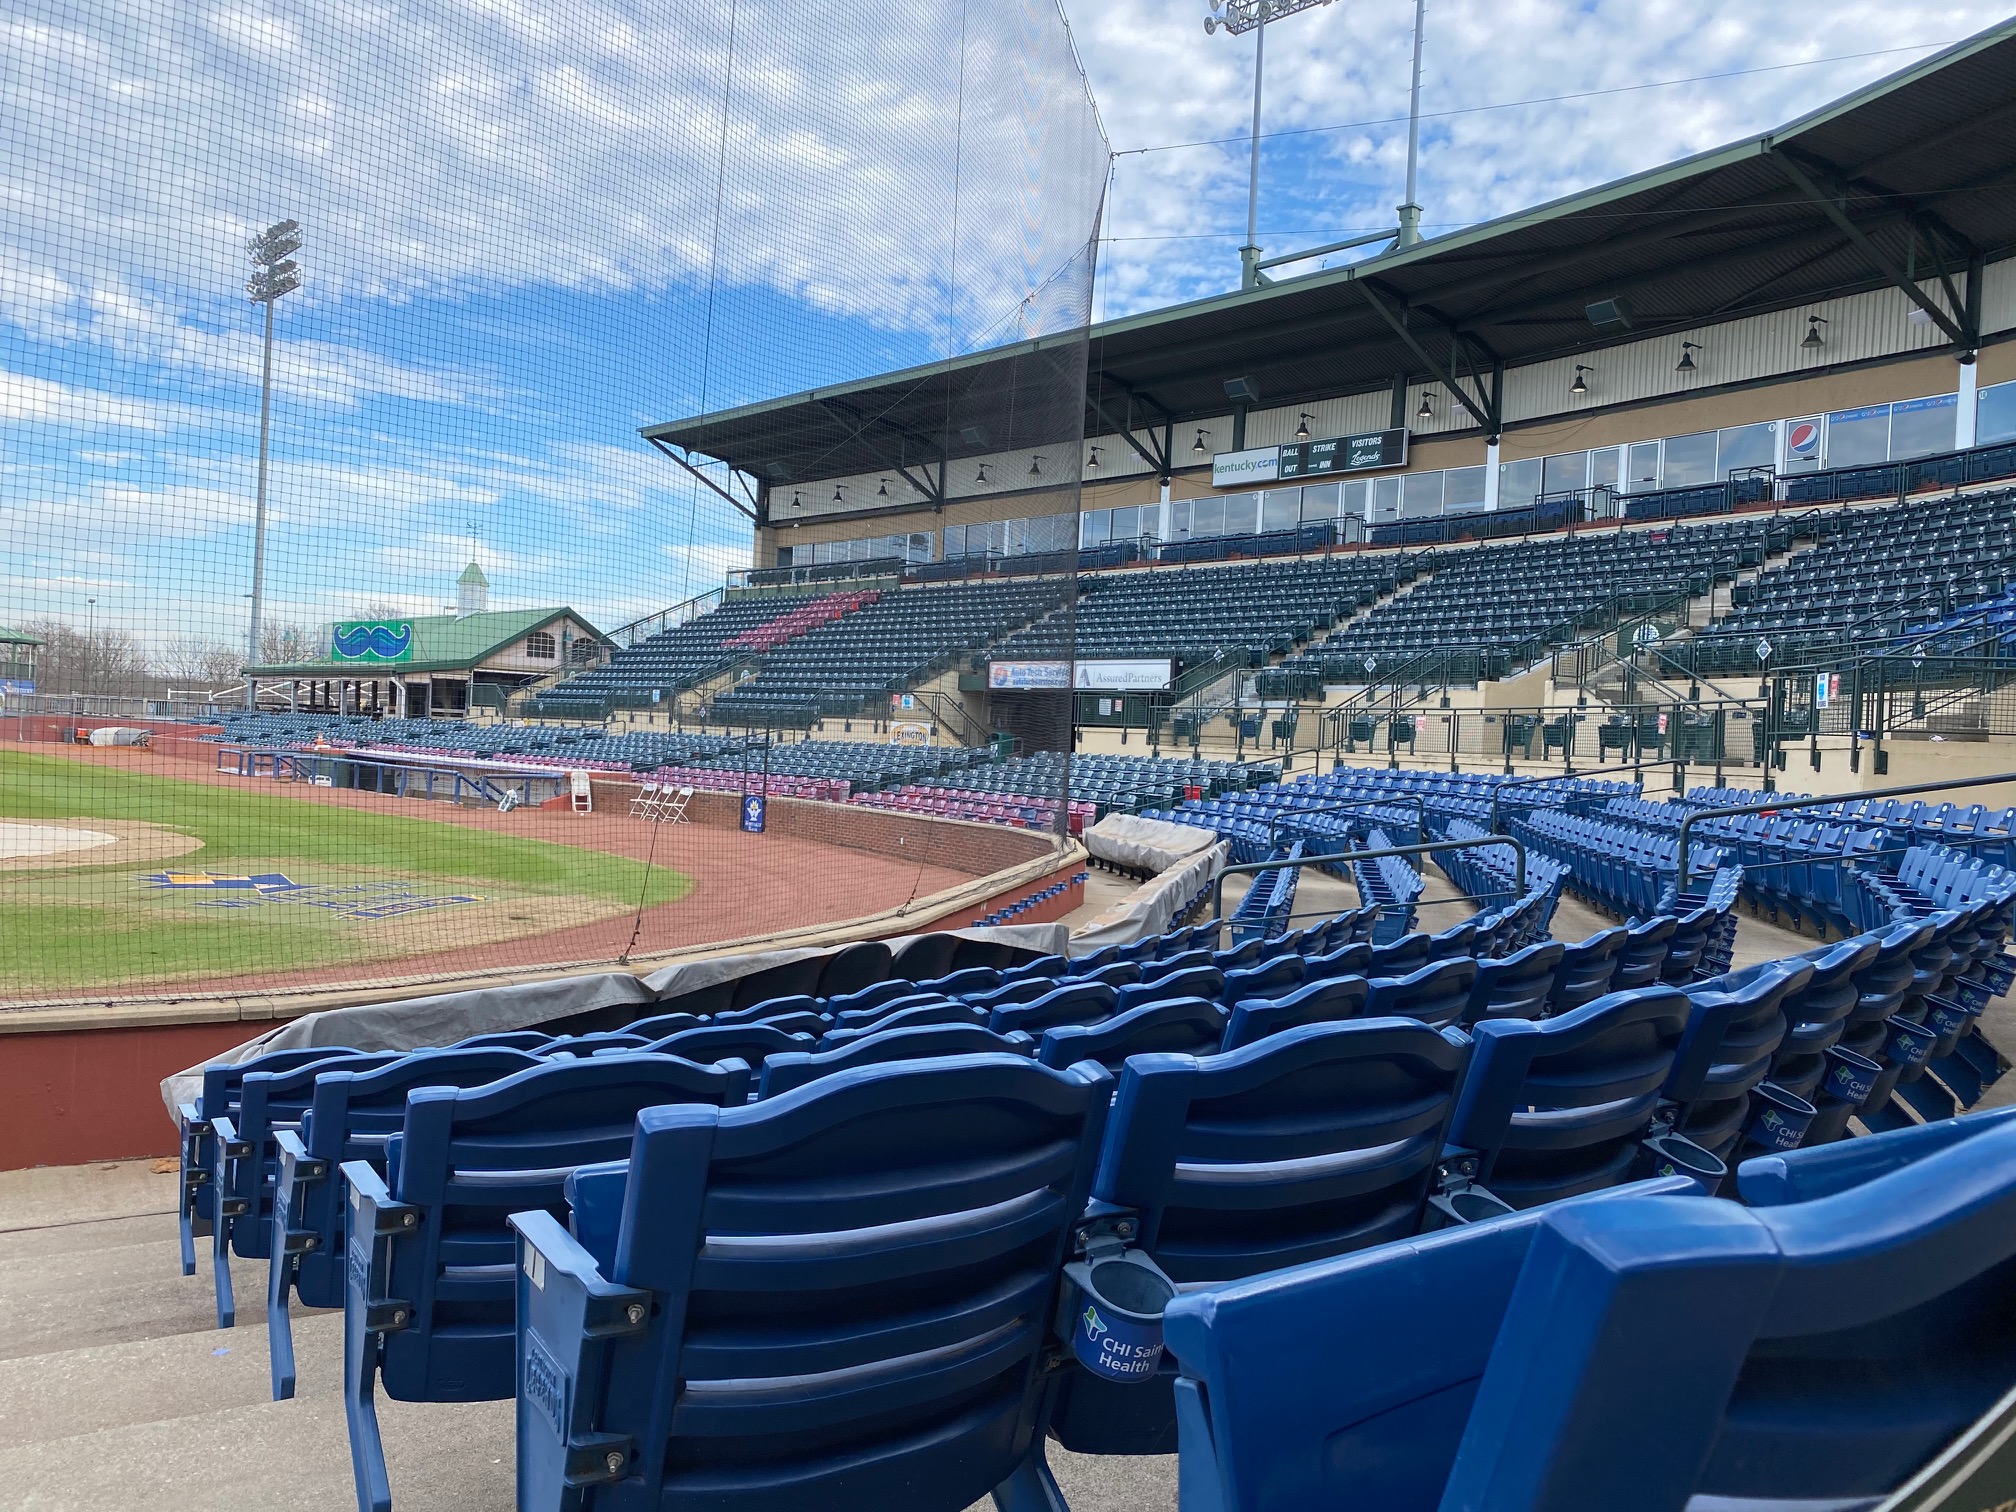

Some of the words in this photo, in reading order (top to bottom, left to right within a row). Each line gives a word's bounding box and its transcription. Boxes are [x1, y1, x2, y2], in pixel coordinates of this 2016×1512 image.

[1312, 443, 1337, 453] STRIKE
[1351, 436, 1382, 448] VISITORS
[1282, 448, 1299, 457] BALL
[1350, 450, 1381, 466] Legends
[1214, 458, 1278, 474] kentucky.com
[1284, 464, 1298, 473] OUT
[1096, 672, 1162, 683] AssuredPartners
[1850, 1081, 1866, 1091] CHI
[1779, 1127, 1797, 1139] CHI
[1102, 1337, 1131, 1357] CHI
[1099, 1352, 1150, 1373] Health
